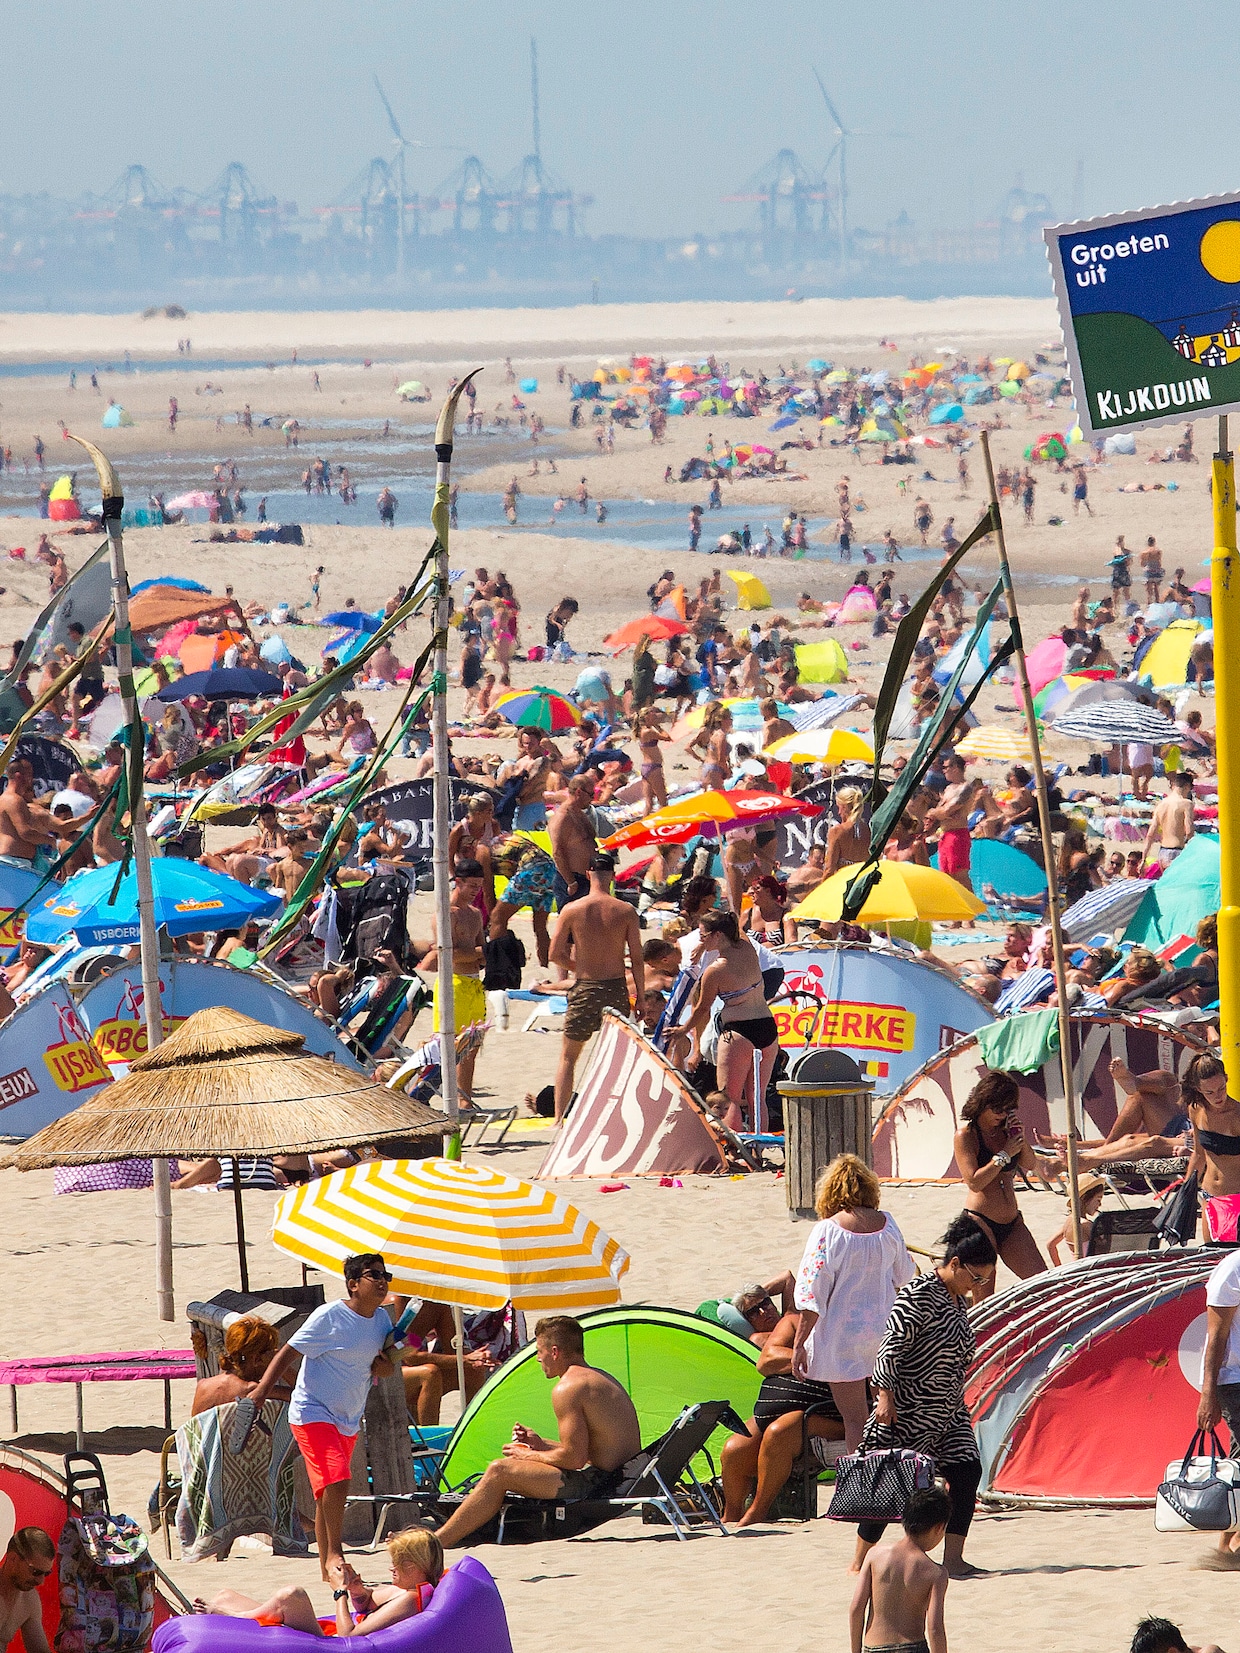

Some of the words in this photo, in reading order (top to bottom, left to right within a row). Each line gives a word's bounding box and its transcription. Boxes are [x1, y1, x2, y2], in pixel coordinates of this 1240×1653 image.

[1070, 232, 1170, 266] Groeten
[1075, 264, 1107, 288] uit
[1096, 376, 1212, 421] KIJKDUIN
[1163, 1491, 1192, 1521] ACTIVE
